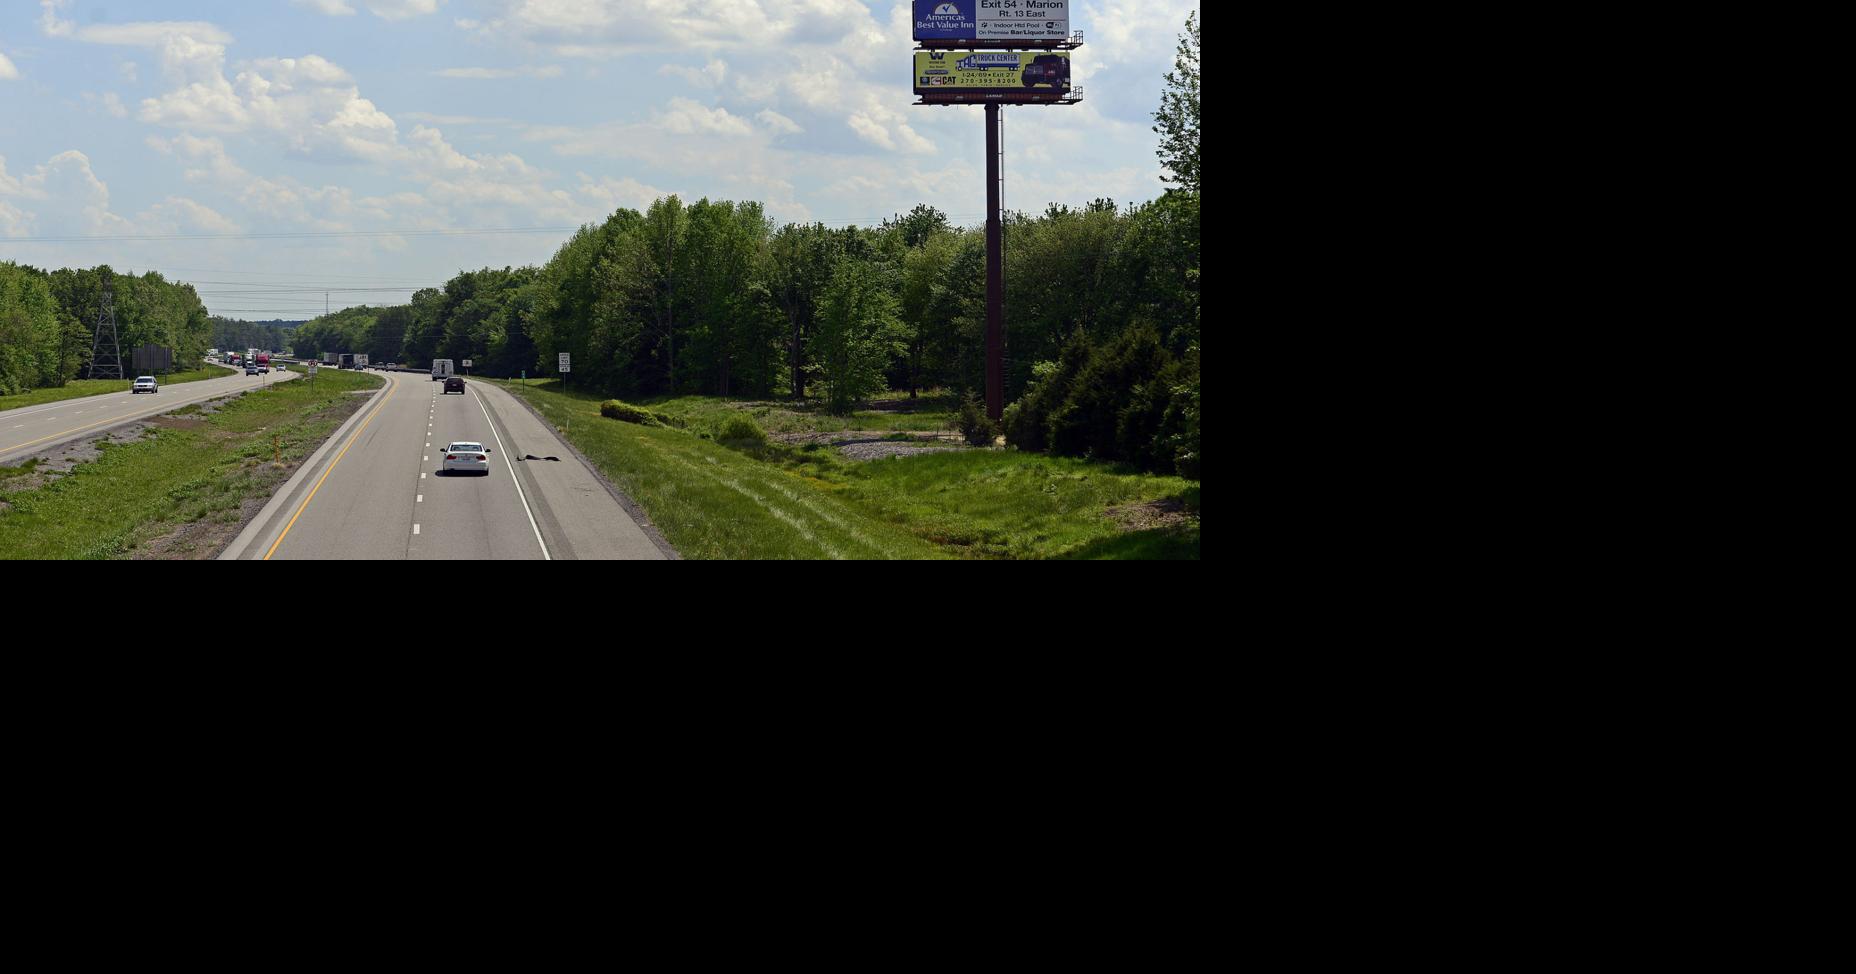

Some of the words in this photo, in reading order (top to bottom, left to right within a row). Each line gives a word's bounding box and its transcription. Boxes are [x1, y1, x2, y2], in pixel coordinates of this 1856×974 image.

[981, 0, 1001, 9] Exit
[1004, 0, 1017, 9] 54
[1026, 0, 1063, 9] Marion
[977, 54, 996, 62] TRUCK
[996, 54, 1018, 62] CENTER
[942, 76, 957, 85] CAT
